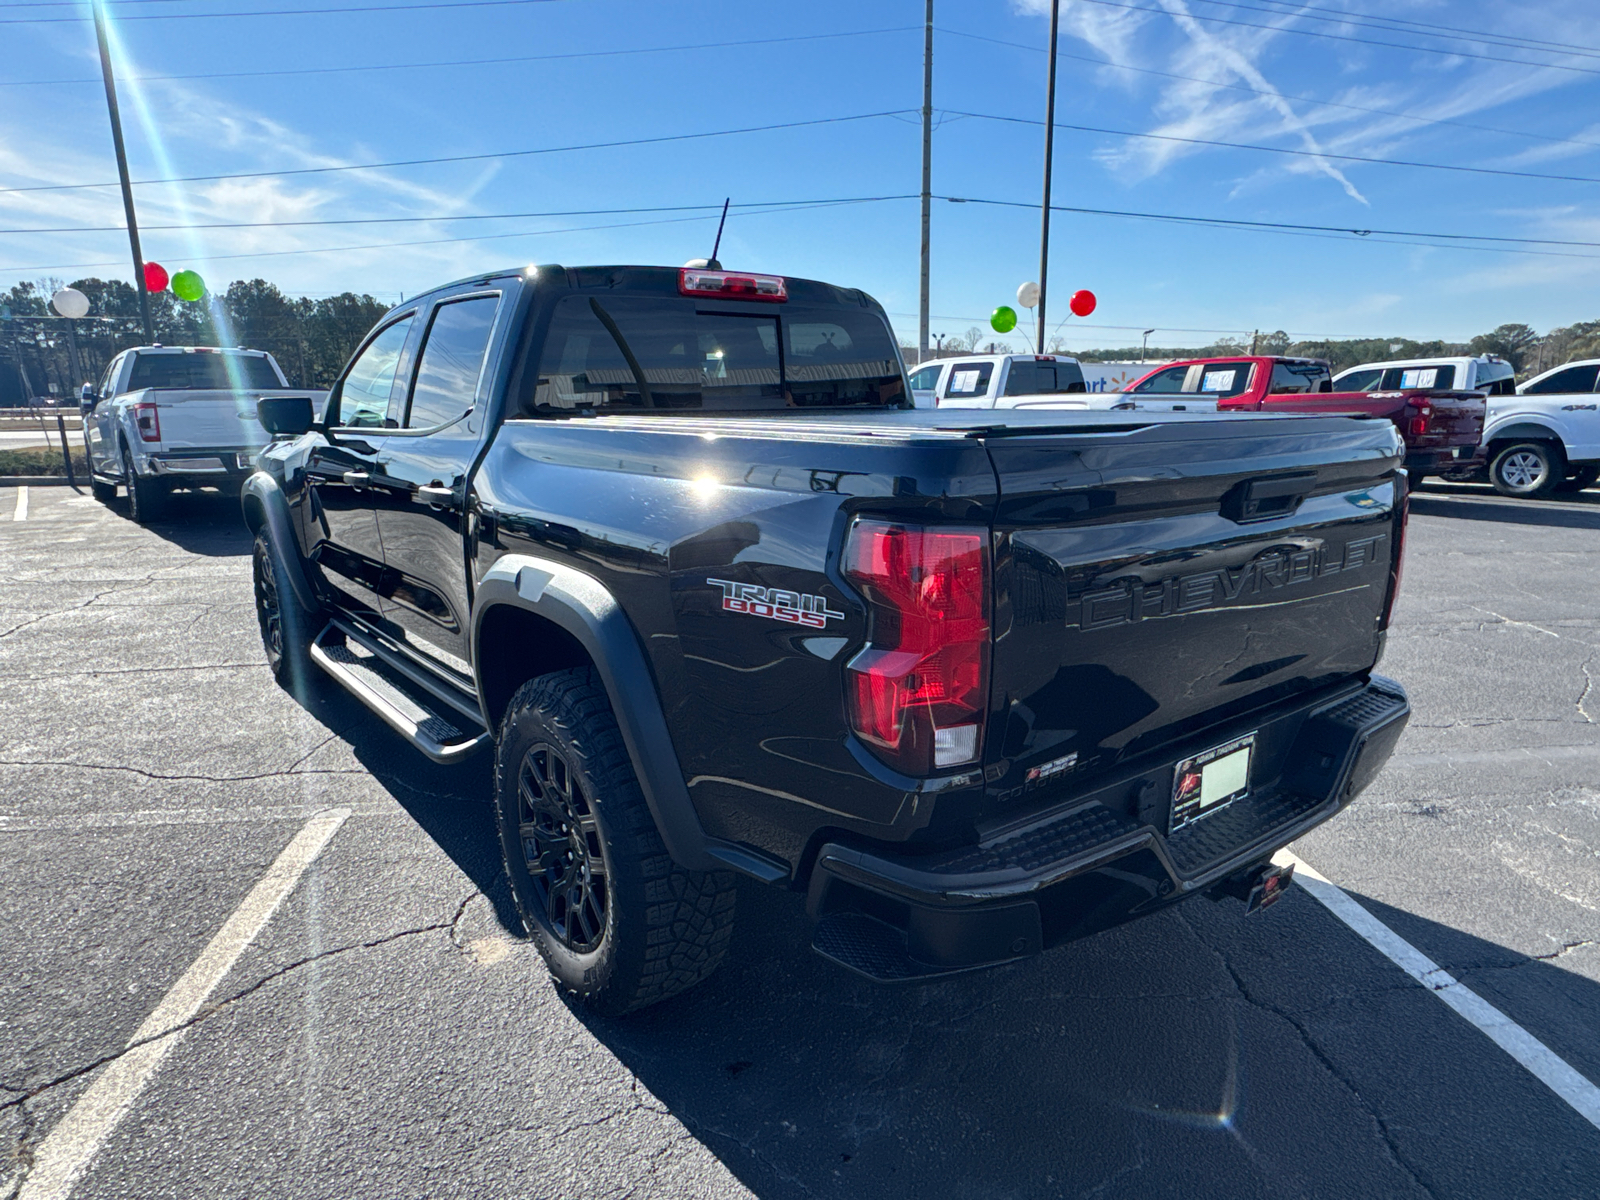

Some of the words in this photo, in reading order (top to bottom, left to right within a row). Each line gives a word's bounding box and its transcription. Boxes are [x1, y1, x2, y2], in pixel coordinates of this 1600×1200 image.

[707, 578, 845, 620] TRAIL
[1079, 533, 1387, 632] CHEVROLET
[722, 597, 827, 629] BOSS
[997, 754, 1101, 802] COLORADO
